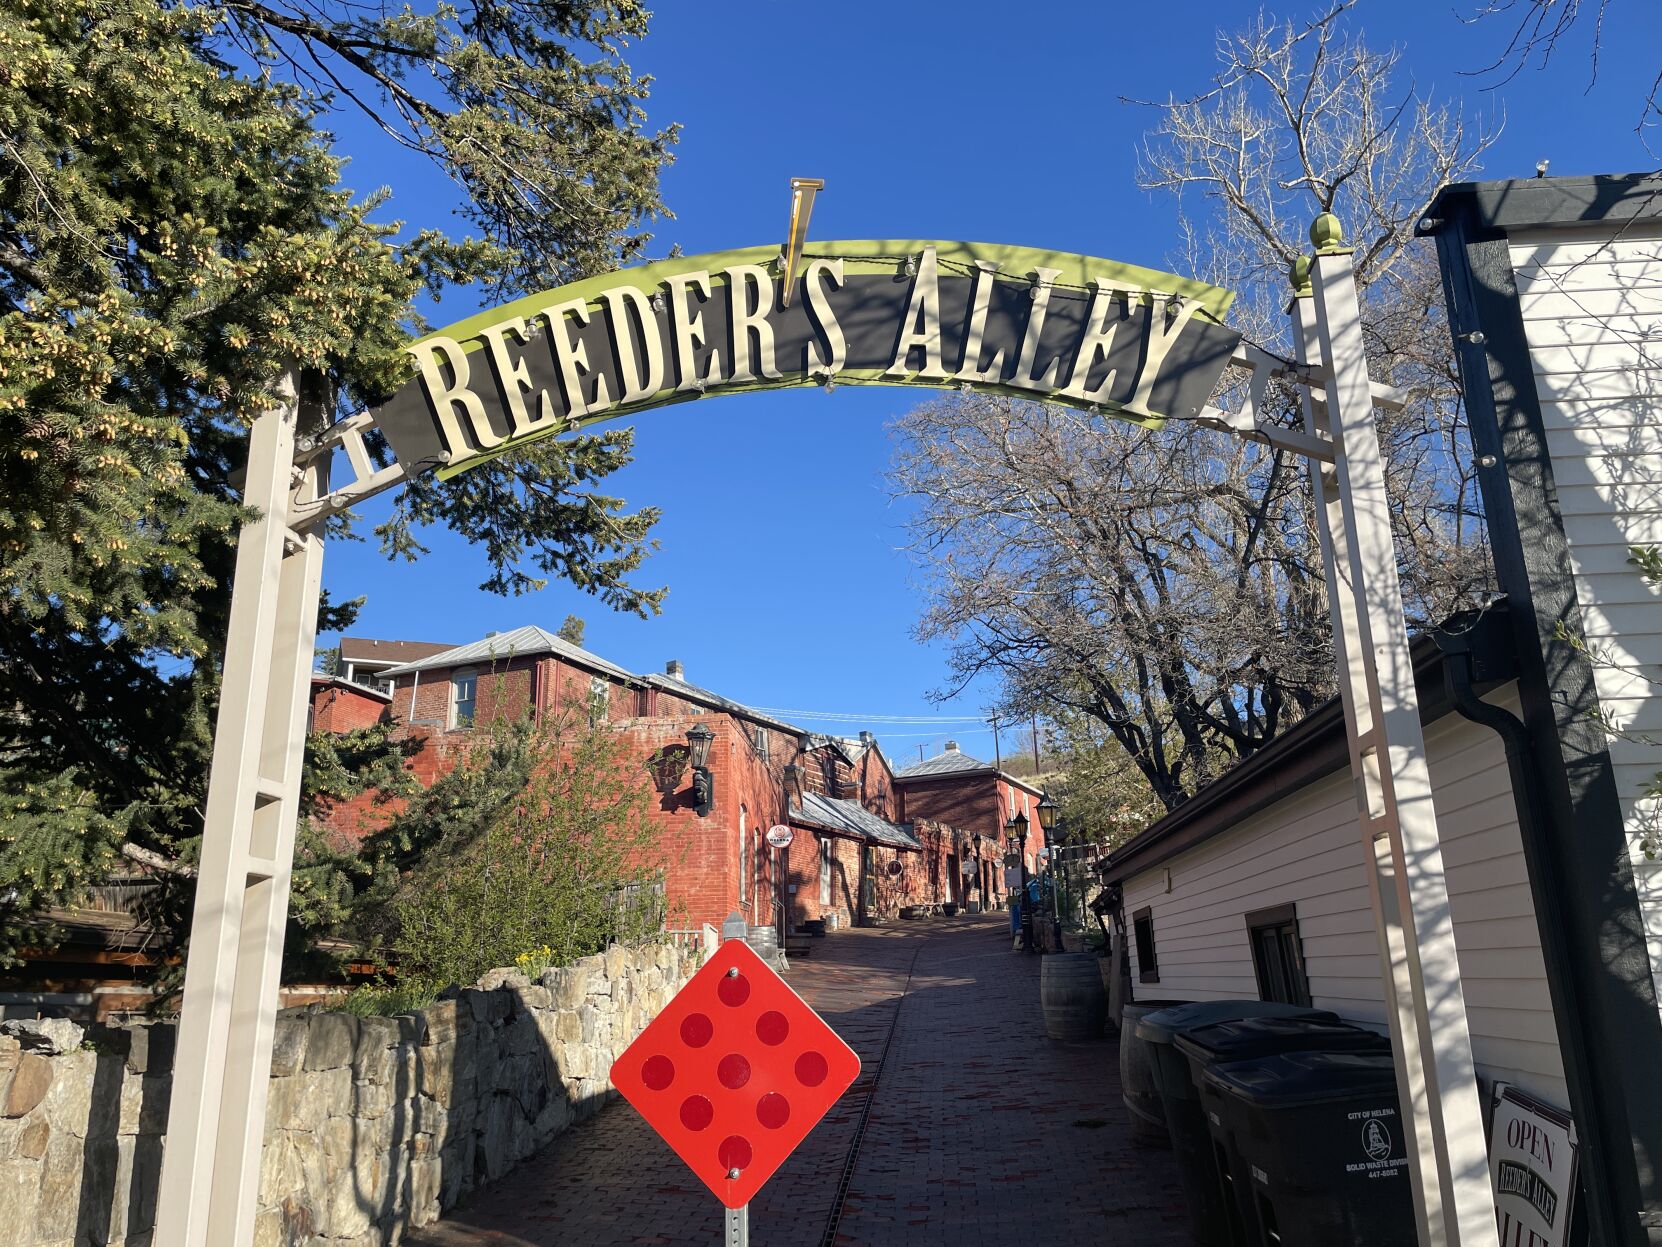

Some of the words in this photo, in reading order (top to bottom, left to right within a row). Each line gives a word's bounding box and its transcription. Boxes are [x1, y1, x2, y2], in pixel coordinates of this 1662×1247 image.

[886, 245, 1206, 417] ALLEY
[1348, 1111, 1362, 1119] CITY
[1362, 1110, 1370, 1118] OF
[1371, 1108, 1395, 1117] HELENA
[1346, 1163, 1366, 1172] SOLID
[1366, 1161, 1389, 1169] WASTE
[1507, 1118, 1555, 1172] OPEN
[1532, 1176, 1555, 1225] ALLEY
